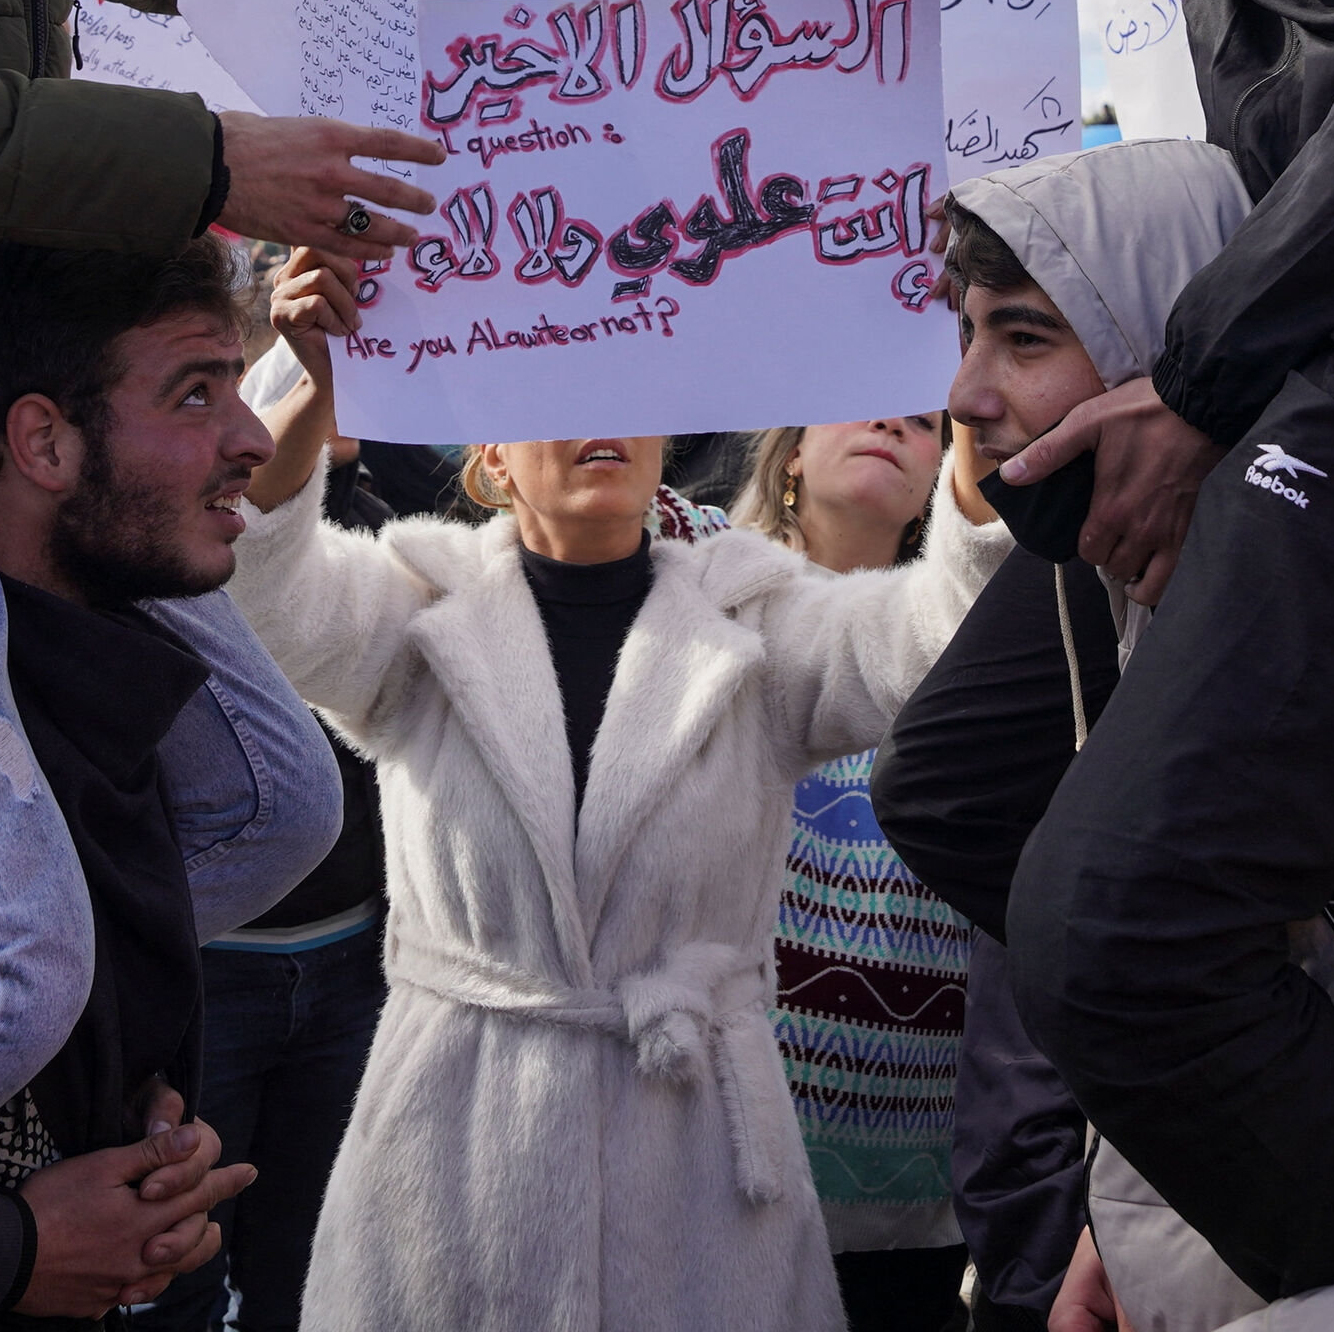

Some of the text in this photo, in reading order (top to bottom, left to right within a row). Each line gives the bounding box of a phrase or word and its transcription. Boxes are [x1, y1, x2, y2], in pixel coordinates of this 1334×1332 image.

[605, 127, 814, 304] علوي
[346, 329, 397, 360] Are
[405, 335, 457, 374] you
[600, 296, 680, 338] not?
[1244, 464, 1310, 509] Reebok
